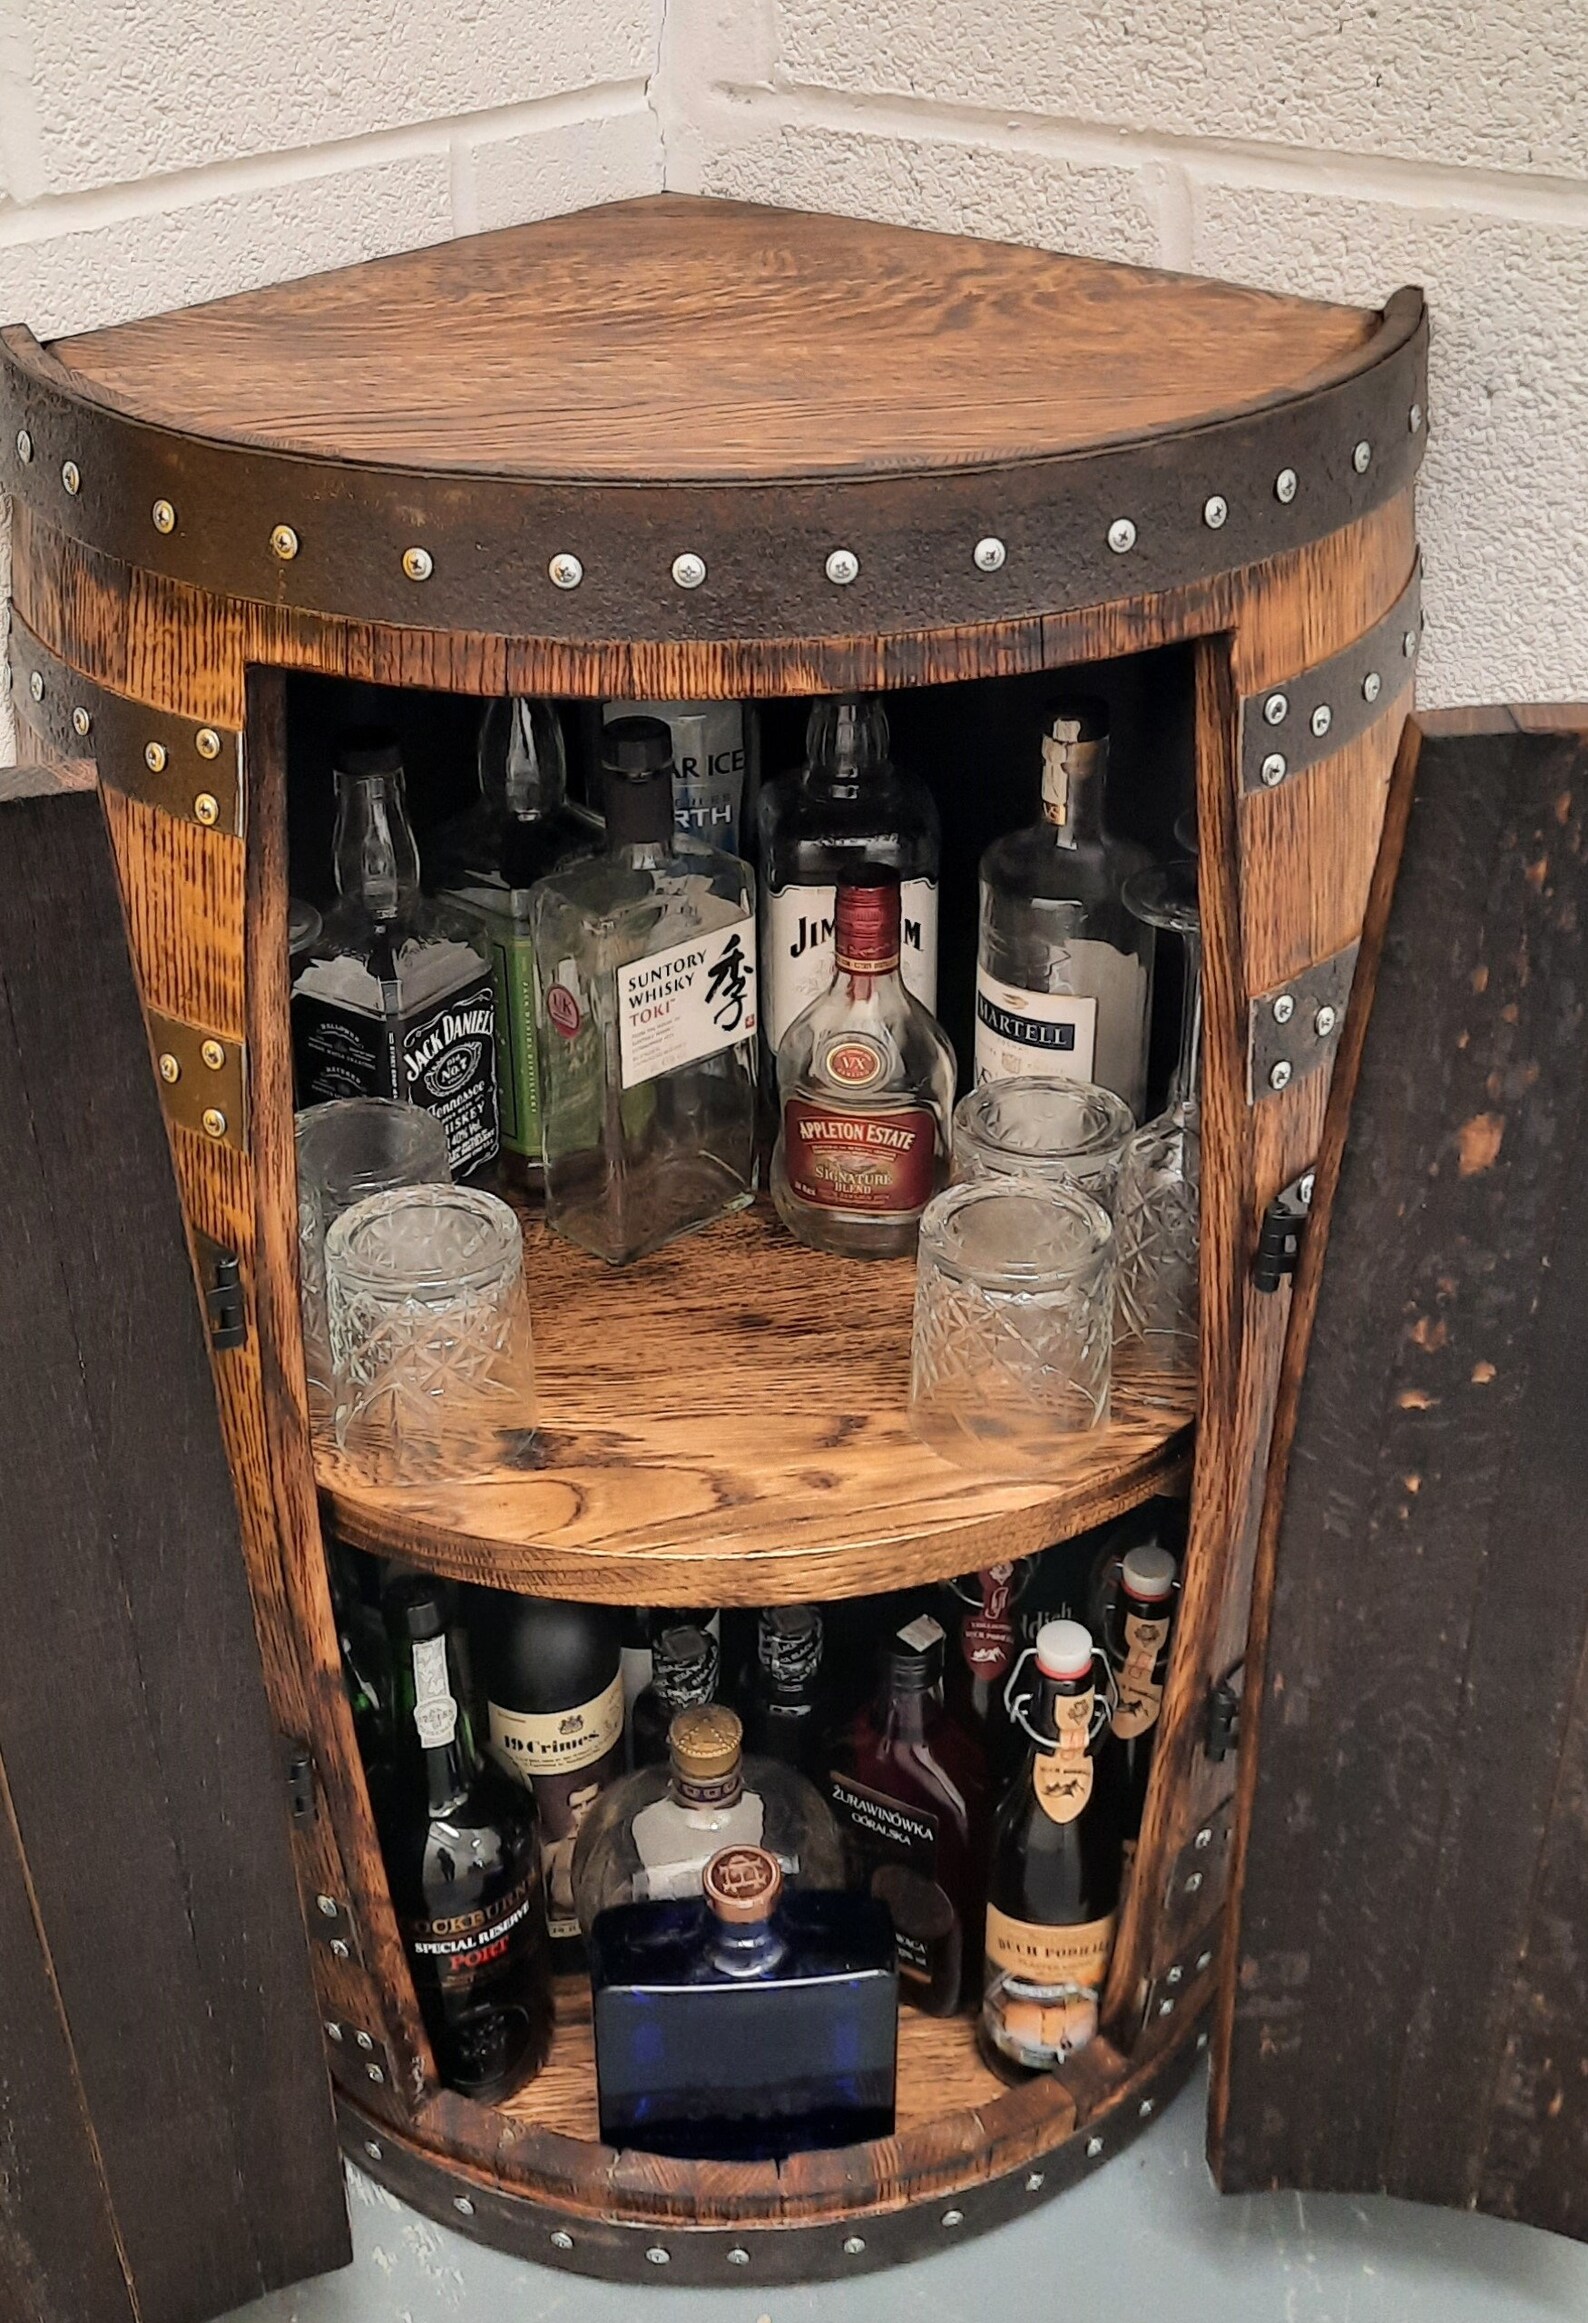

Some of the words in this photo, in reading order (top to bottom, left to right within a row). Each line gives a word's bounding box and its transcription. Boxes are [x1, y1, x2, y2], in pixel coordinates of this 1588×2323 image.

[708, 749, 745, 776] ICE
[628, 949, 708, 993] SUNTORY
[628, 971, 696, 1010] WHISKY
[628, 1000, 671, 1028] TOKI
[979, 998, 1068, 1046] MARTELL
[403, 1028, 444, 1081] JACK
[799, 1120, 865, 1142] APPLETON
[866, 1124, 917, 1150] ESTATE
[814, 1163, 894, 1186] SIGNATURE
[834, 1181, 872, 1195] BLEND
[527, 1730, 600, 1754] Crimes
[414, 1936, 477, 1955] SPECIAL
[478, 1898, 530, 1945] RESERVE
[450, 1934, 510, 1971] PORT
